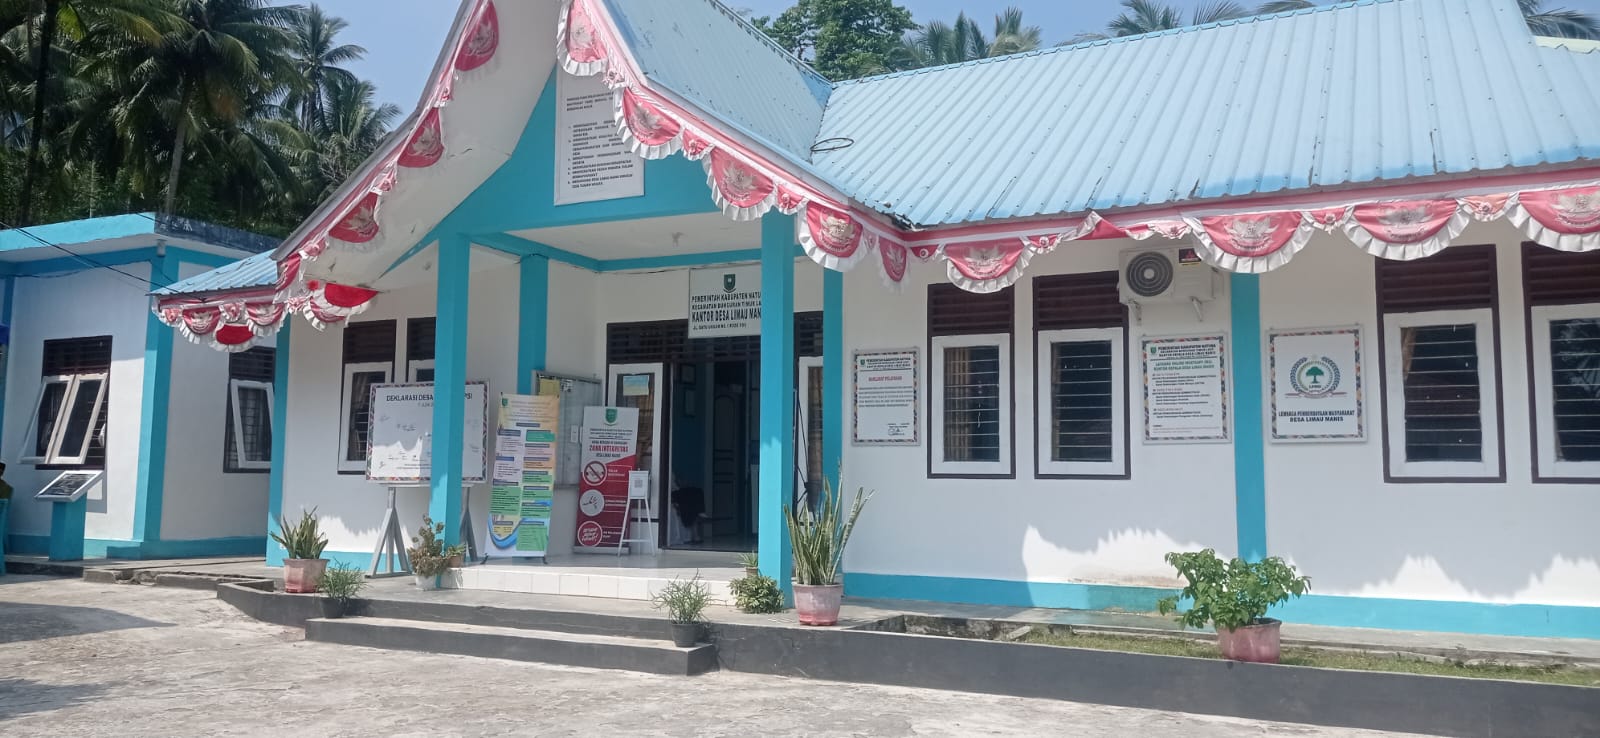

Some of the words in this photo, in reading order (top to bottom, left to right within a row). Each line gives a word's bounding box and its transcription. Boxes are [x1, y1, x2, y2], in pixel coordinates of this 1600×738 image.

[692, 294, 720, 302] PEMERINTAH
[721, 292, 747, 301] KABUPATEN
[692, 310, 714, 322] KANTOR
[716, 309, 730, 321] DESA
[731, 308, 748, 320] LIMAU
